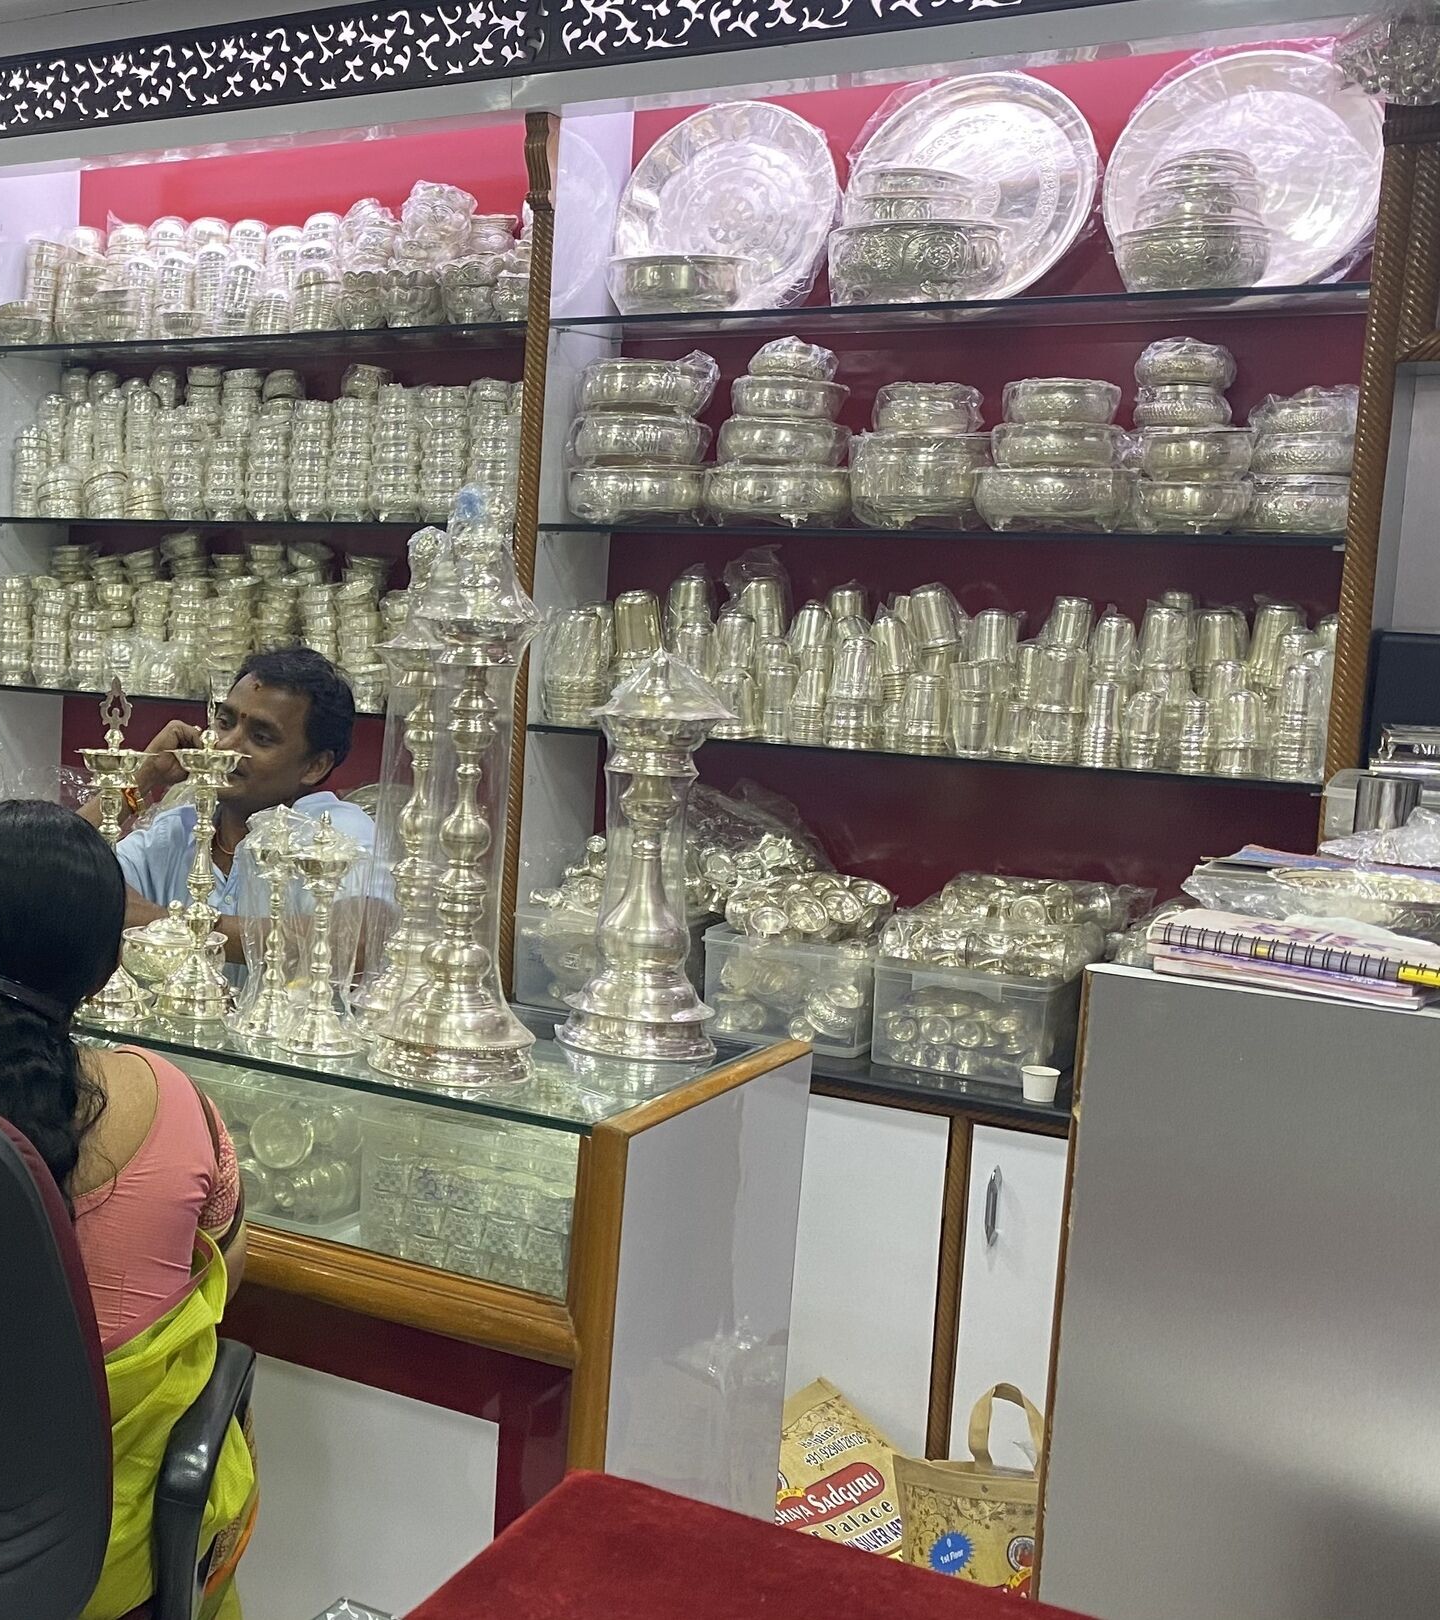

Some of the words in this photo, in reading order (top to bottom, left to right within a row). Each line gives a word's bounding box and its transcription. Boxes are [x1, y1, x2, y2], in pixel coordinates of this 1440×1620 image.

[805, 1451, 824, 1466] +91
[825, 1500, 894, 1536] Palace
[854, 1527, 894, 1551] SILVER
